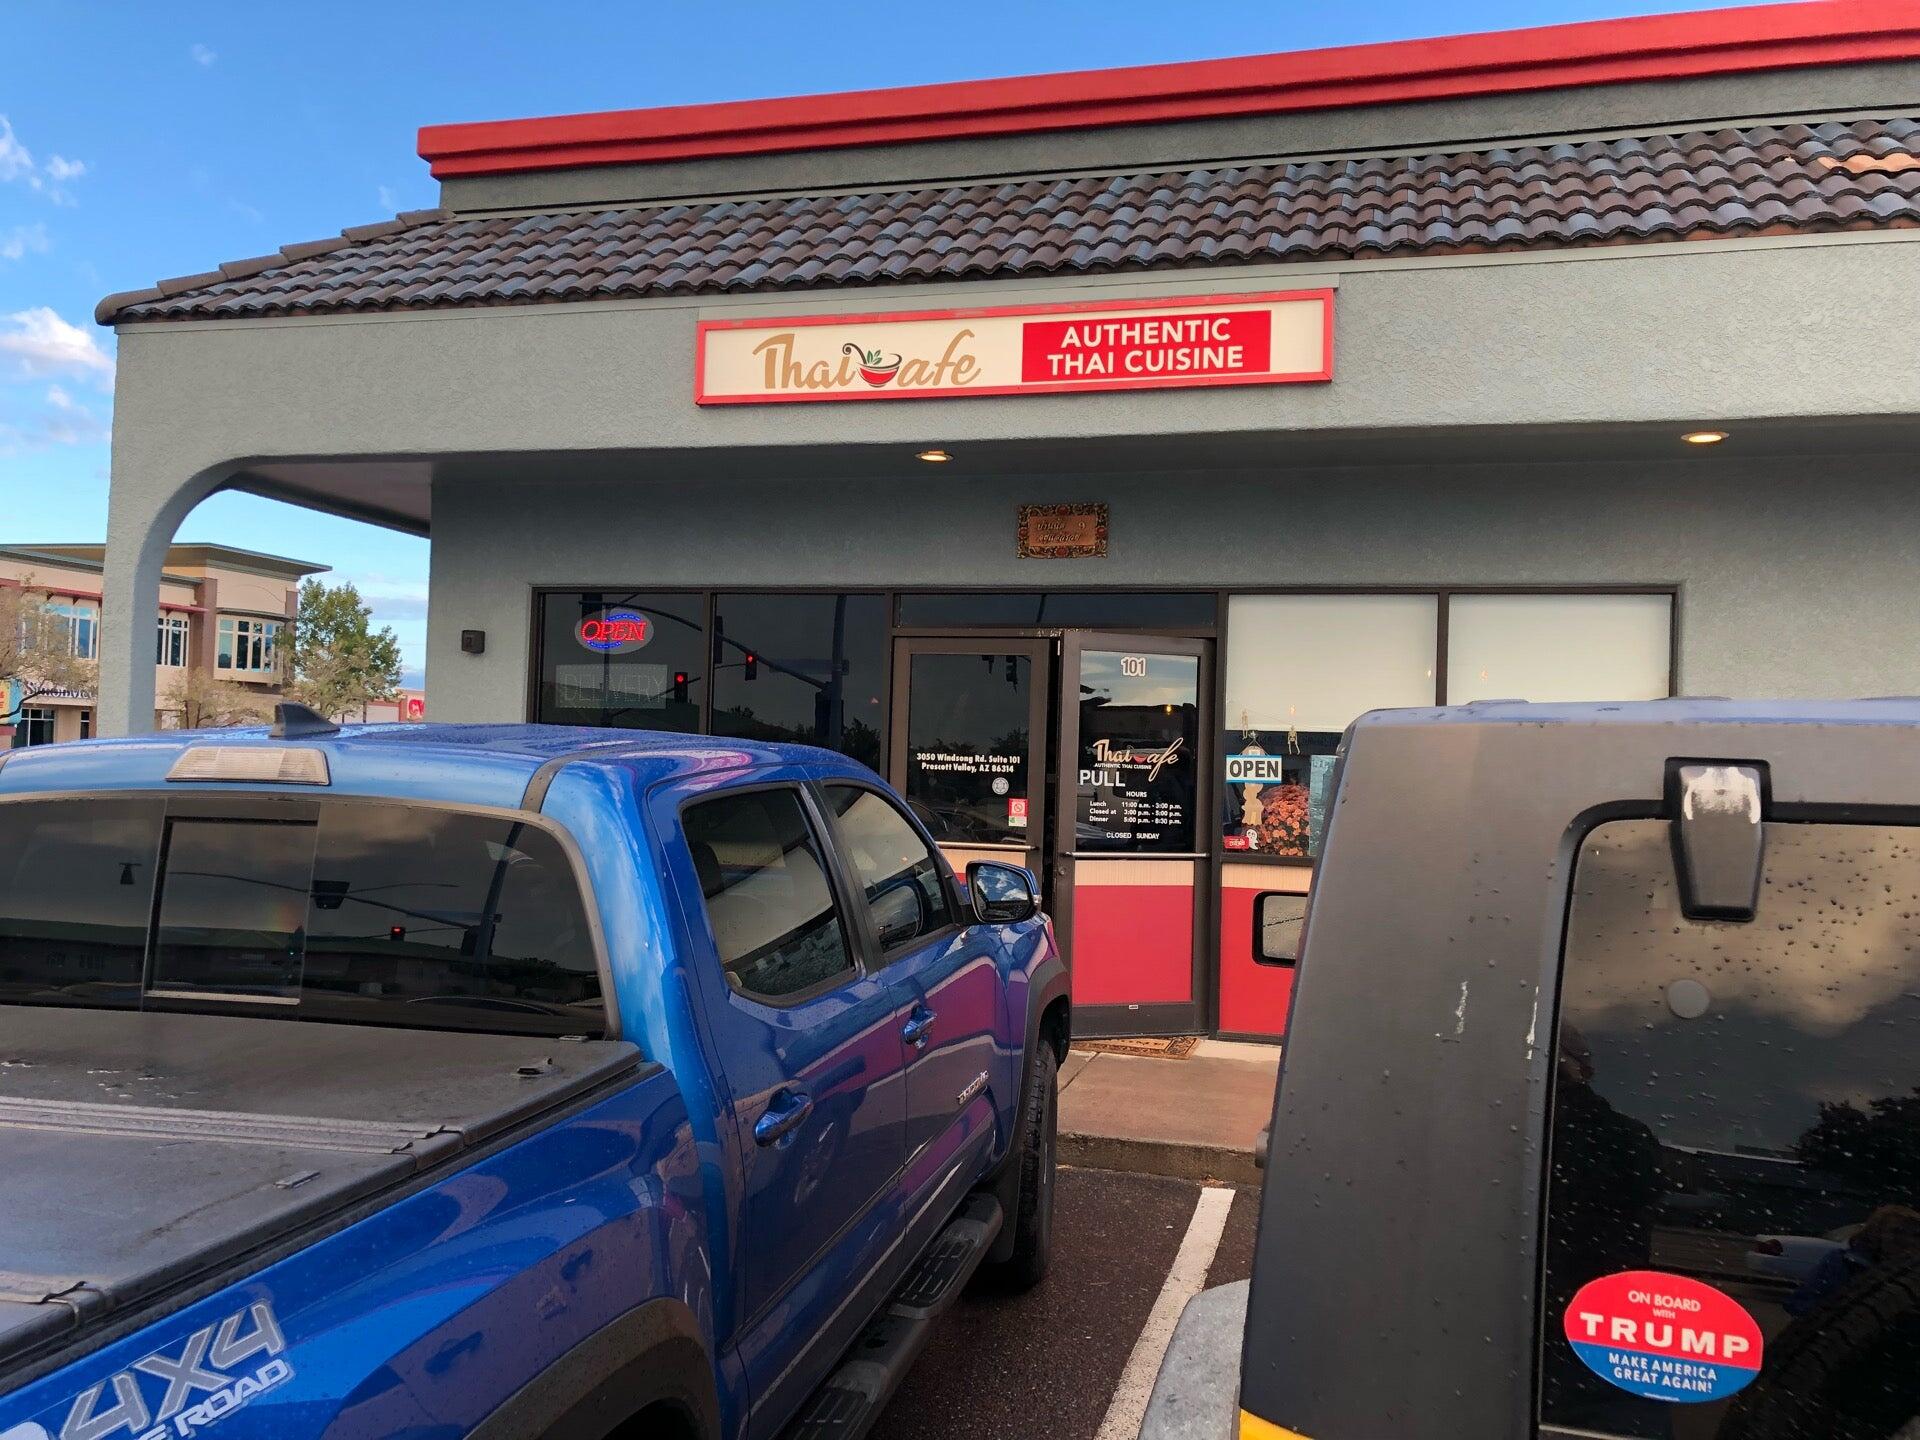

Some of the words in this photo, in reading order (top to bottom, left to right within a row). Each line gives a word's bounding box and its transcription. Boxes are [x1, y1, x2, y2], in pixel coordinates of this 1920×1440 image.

[1060, 317, 1231, 349] AUTHENTIC
[752, 333, 856, 390] Thai
[1047, 351, 1114, 376] THAI
[1124, 345, 1244, 373] CUISINE
[581, 620, 647, 641] OPEN
[1121, 656, 1146, 677] 101
[916, 752, 936, 761] 3050
[937, 753, 974, 764] Windsong
[975, 755, 987, 763] Rd.
[988, 755, 1008, 764] Suite
[1009, 756, 1021, 764] 101
[1092, 738, 1132, 763] Thai
[921, 762, 952, 771] Prescott
[952, 763, 977, 773] Valley,
[991, 765, 1014, 773] 86314
[1080, 769, 1126, 787] PULL
[1229, 760, 1279, 778] OPEN
[1628, 1290, 1651, 1304] ON
[1654, 1294, 1701, 1312] BOARD
[1653, 1309, 1676, 1319] WITH
[1579, 1312, 1750, 1359] TRUMP
[59, 1299, 286, 1440] 4X4
[1608, 1352, 1648, 1370] MAKE
[1651, 1359, 1718, 1381] AMERICA
[1613, 1367, 1658, 1385] GREAT
[1661, 1375, 1713, 1393] AGAIN!
[174, 1359, 291, 1437] ROAD
